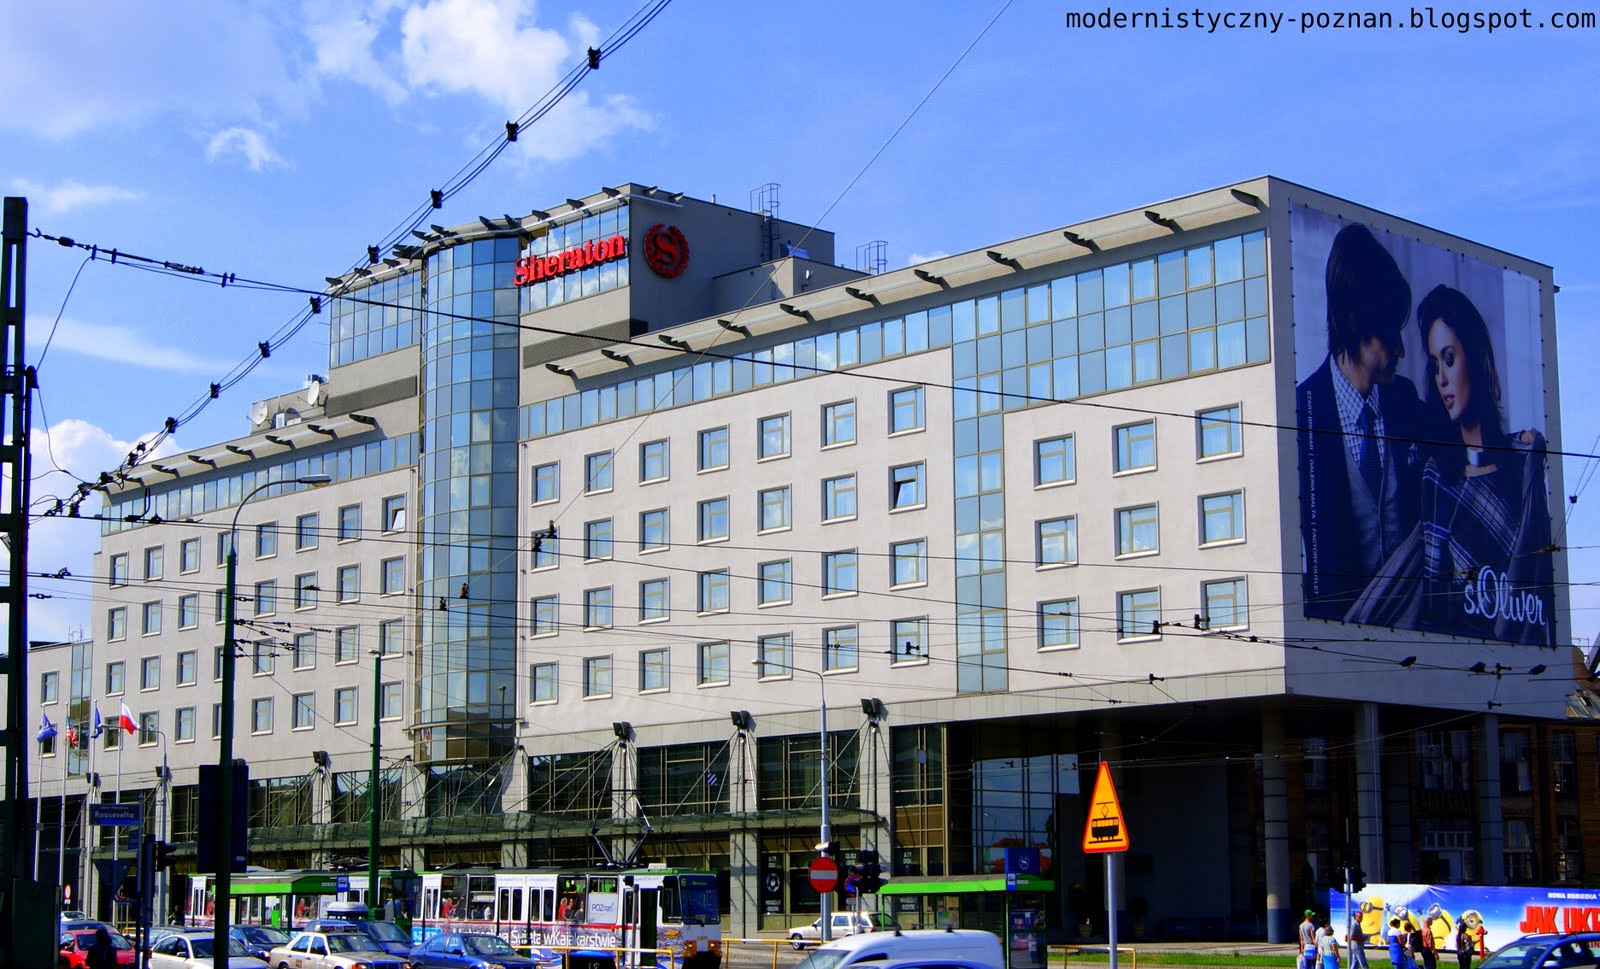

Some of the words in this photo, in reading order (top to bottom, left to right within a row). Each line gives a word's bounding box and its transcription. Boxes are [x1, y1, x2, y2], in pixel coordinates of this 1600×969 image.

[514, 234, 626, 286] Sheraton
[1464, 565, 1546, 625] s.Oliver
[94, 811, 135, 819] Roosevelta
[681, 878, 687, 887] 6
[1519, 905, 1559, 935] JAK
